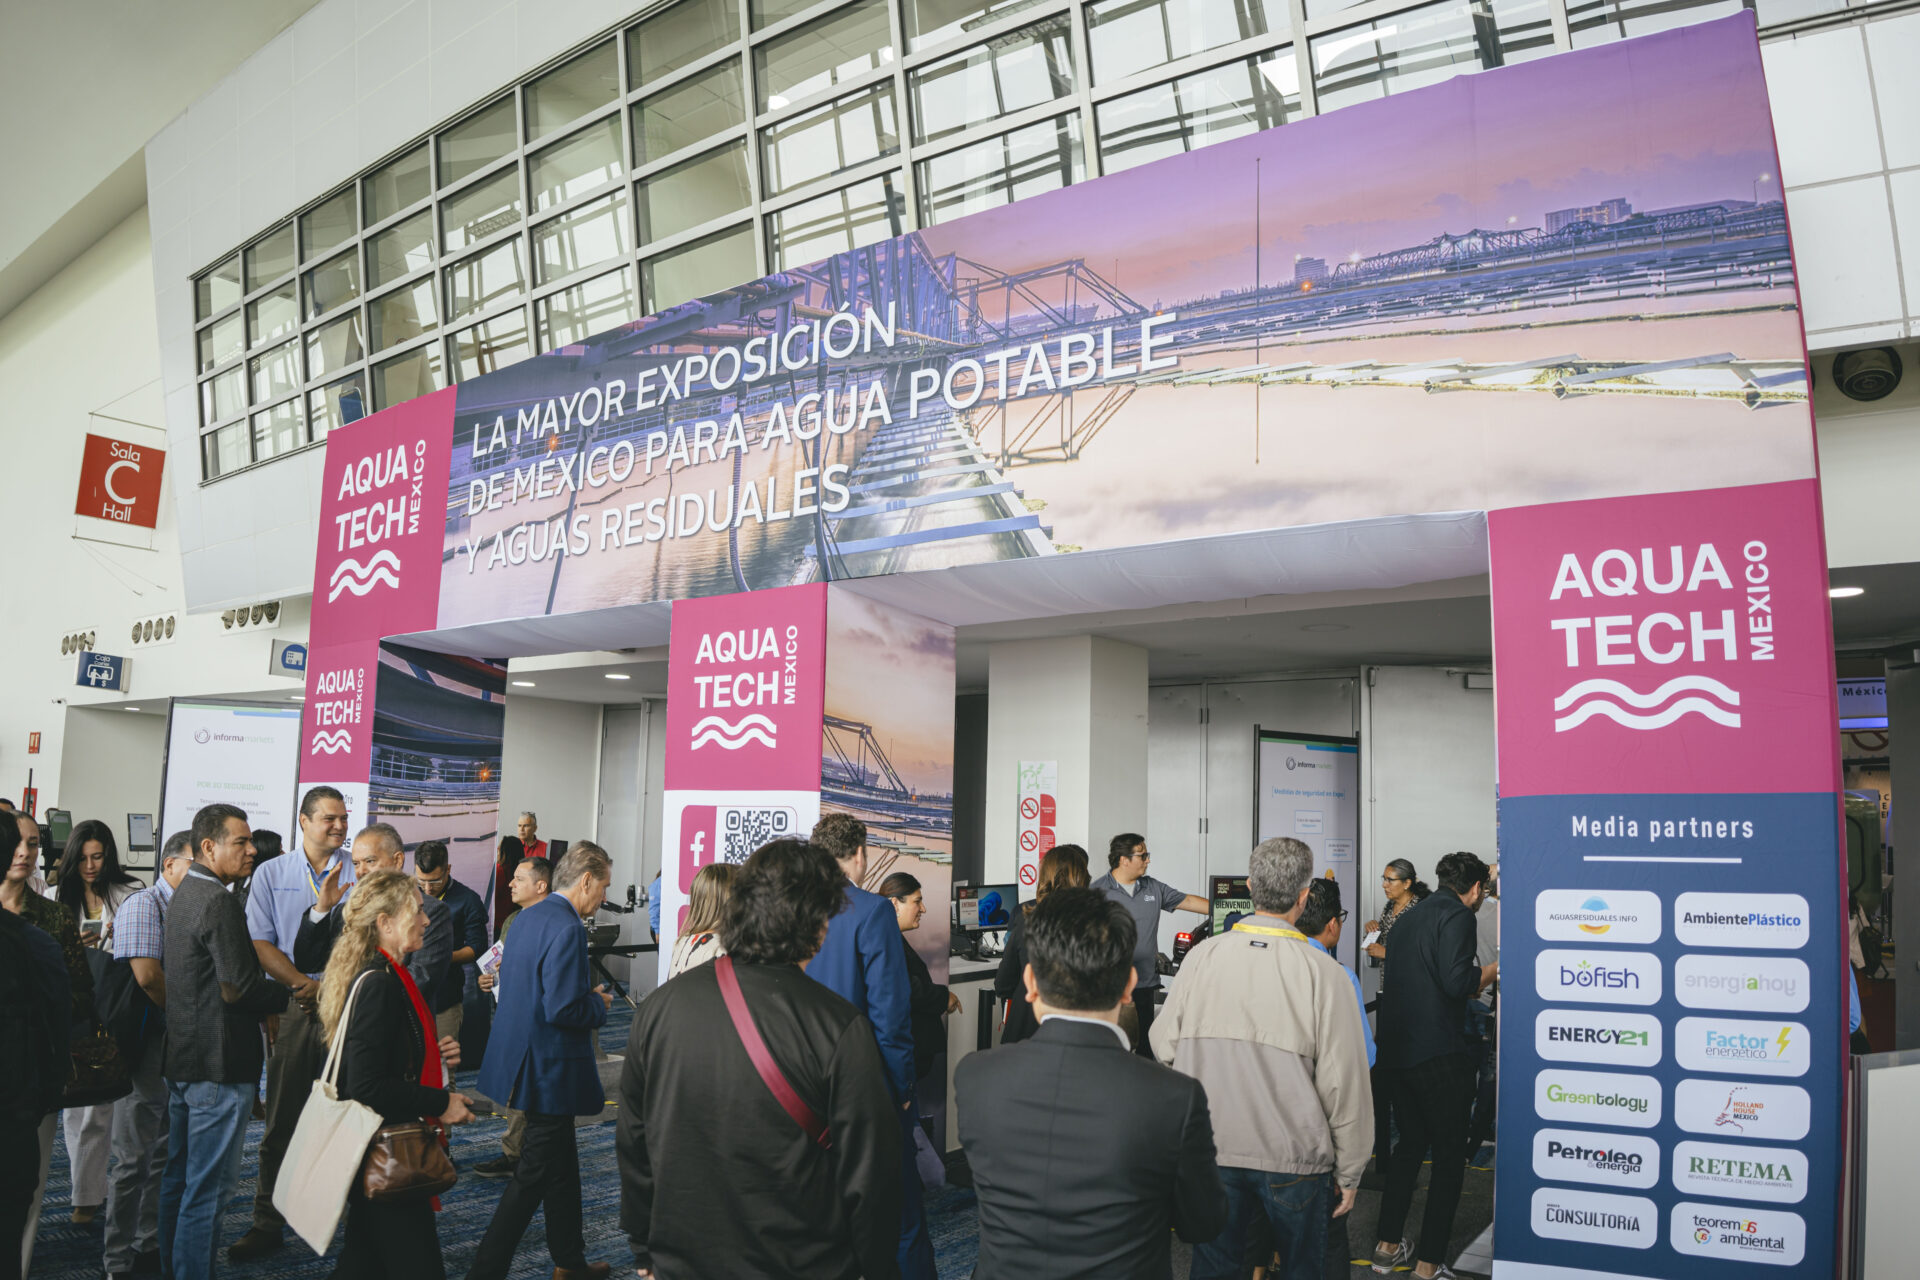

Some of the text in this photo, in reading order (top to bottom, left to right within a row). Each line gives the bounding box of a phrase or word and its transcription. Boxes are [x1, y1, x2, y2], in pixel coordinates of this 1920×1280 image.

[471, 300, 897, 458] LA MAYOR EXPOSICIÓN
[467, 311, 1179, 517] DE MÉXICO PARA AGUA POTABLE
[110, 441, 141, 463] Sala
[104, 459, 141, 505] C
[336, 445, 409, 501] AQUA
[407, 439, 427, 535] MEXICO
[102, 502, 132, 523] Hall
[335, 496, 405, 552] TECH
[465, 462, 851, 574] Y AGUAS RESIDUALES
[1549, 542, 1734, 601] AQUA
[1743, 540, 1776, 661] MEXICO
[694, 626, 781, 665] AQUA
[1550, 609, 1738, 668] TECH
[783, 625, 799, 705] MEXICO
[315, 668, 356, 695] AQUA
[354, 667, 365, 724] MEXICO
[693, 670, 780, 709] TECH
[314, 699, 355, 726] TECH
[1572, 816, 1754, 842] Media partners
[1216, 901, 1251, 909] BIENVENIDO
[1683, 912, 1801, 926] AmbientePlástico
[1705, 1046, 1767, 1059] energético
[1706, 1030, 1768, 1050] Factor
[1546, 1084, 1648, 1113] Greentology
[1733, 1101, 1764, 1109] HOLLAND
[1733, 1107, 1756, 1115] HOUSE
[1547, 1140, 1643, 1166] Petroleo
[1689, 1156, 1793, 1182] RETEMA
[1720, 1233, 1785, 1250] ambiental
